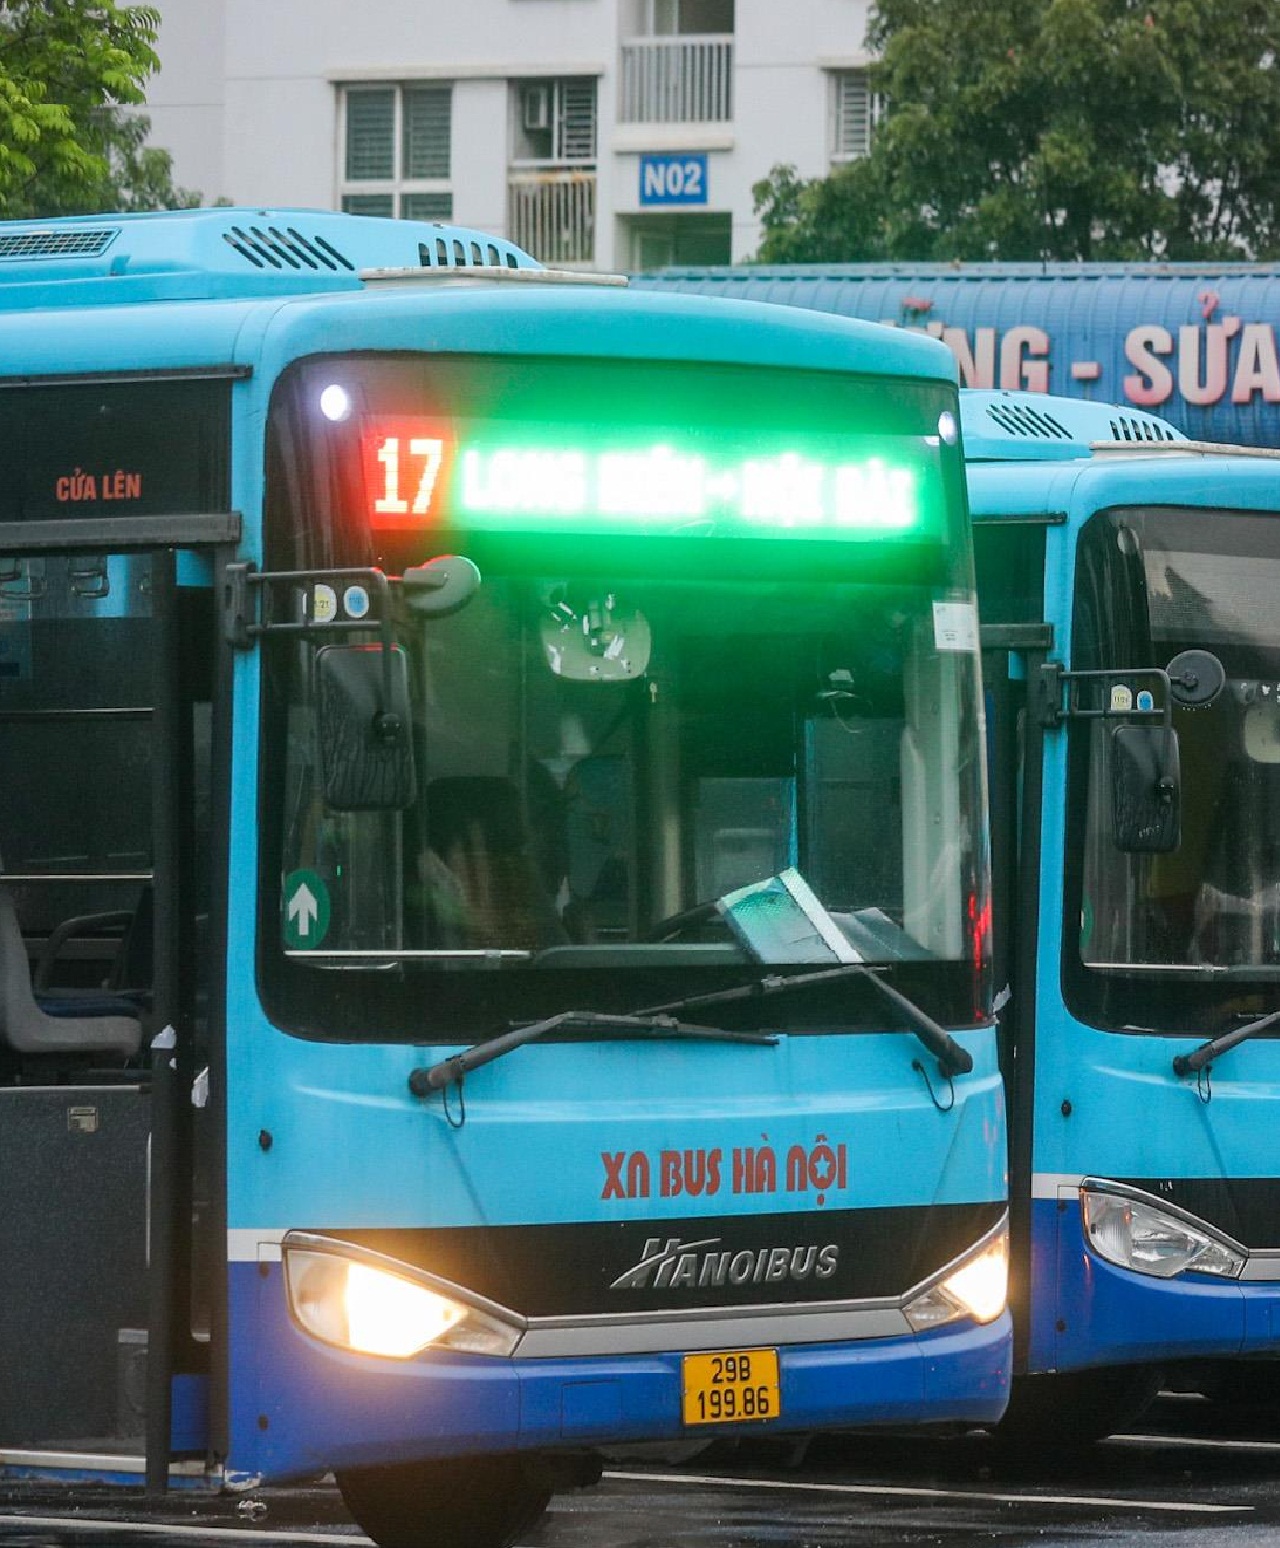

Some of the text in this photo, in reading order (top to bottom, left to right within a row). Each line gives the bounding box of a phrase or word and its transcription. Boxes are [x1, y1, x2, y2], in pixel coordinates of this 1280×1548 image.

[644, 163, 702, 197] N02
[56, 466, 142, 501] CỬA LÊN
[374, 437, 443, 514] 17
[660, 1147, 722, 1197] BUS
[732, 1132, 776, 1194] HÀ
[786, 1133, 847, 1206] NỘI
[609, 1237, 840, 1291] HANOIBUS
[711, 1354, 752, 1385] 29B
[697, 1385, 770, 1420] 199.86
